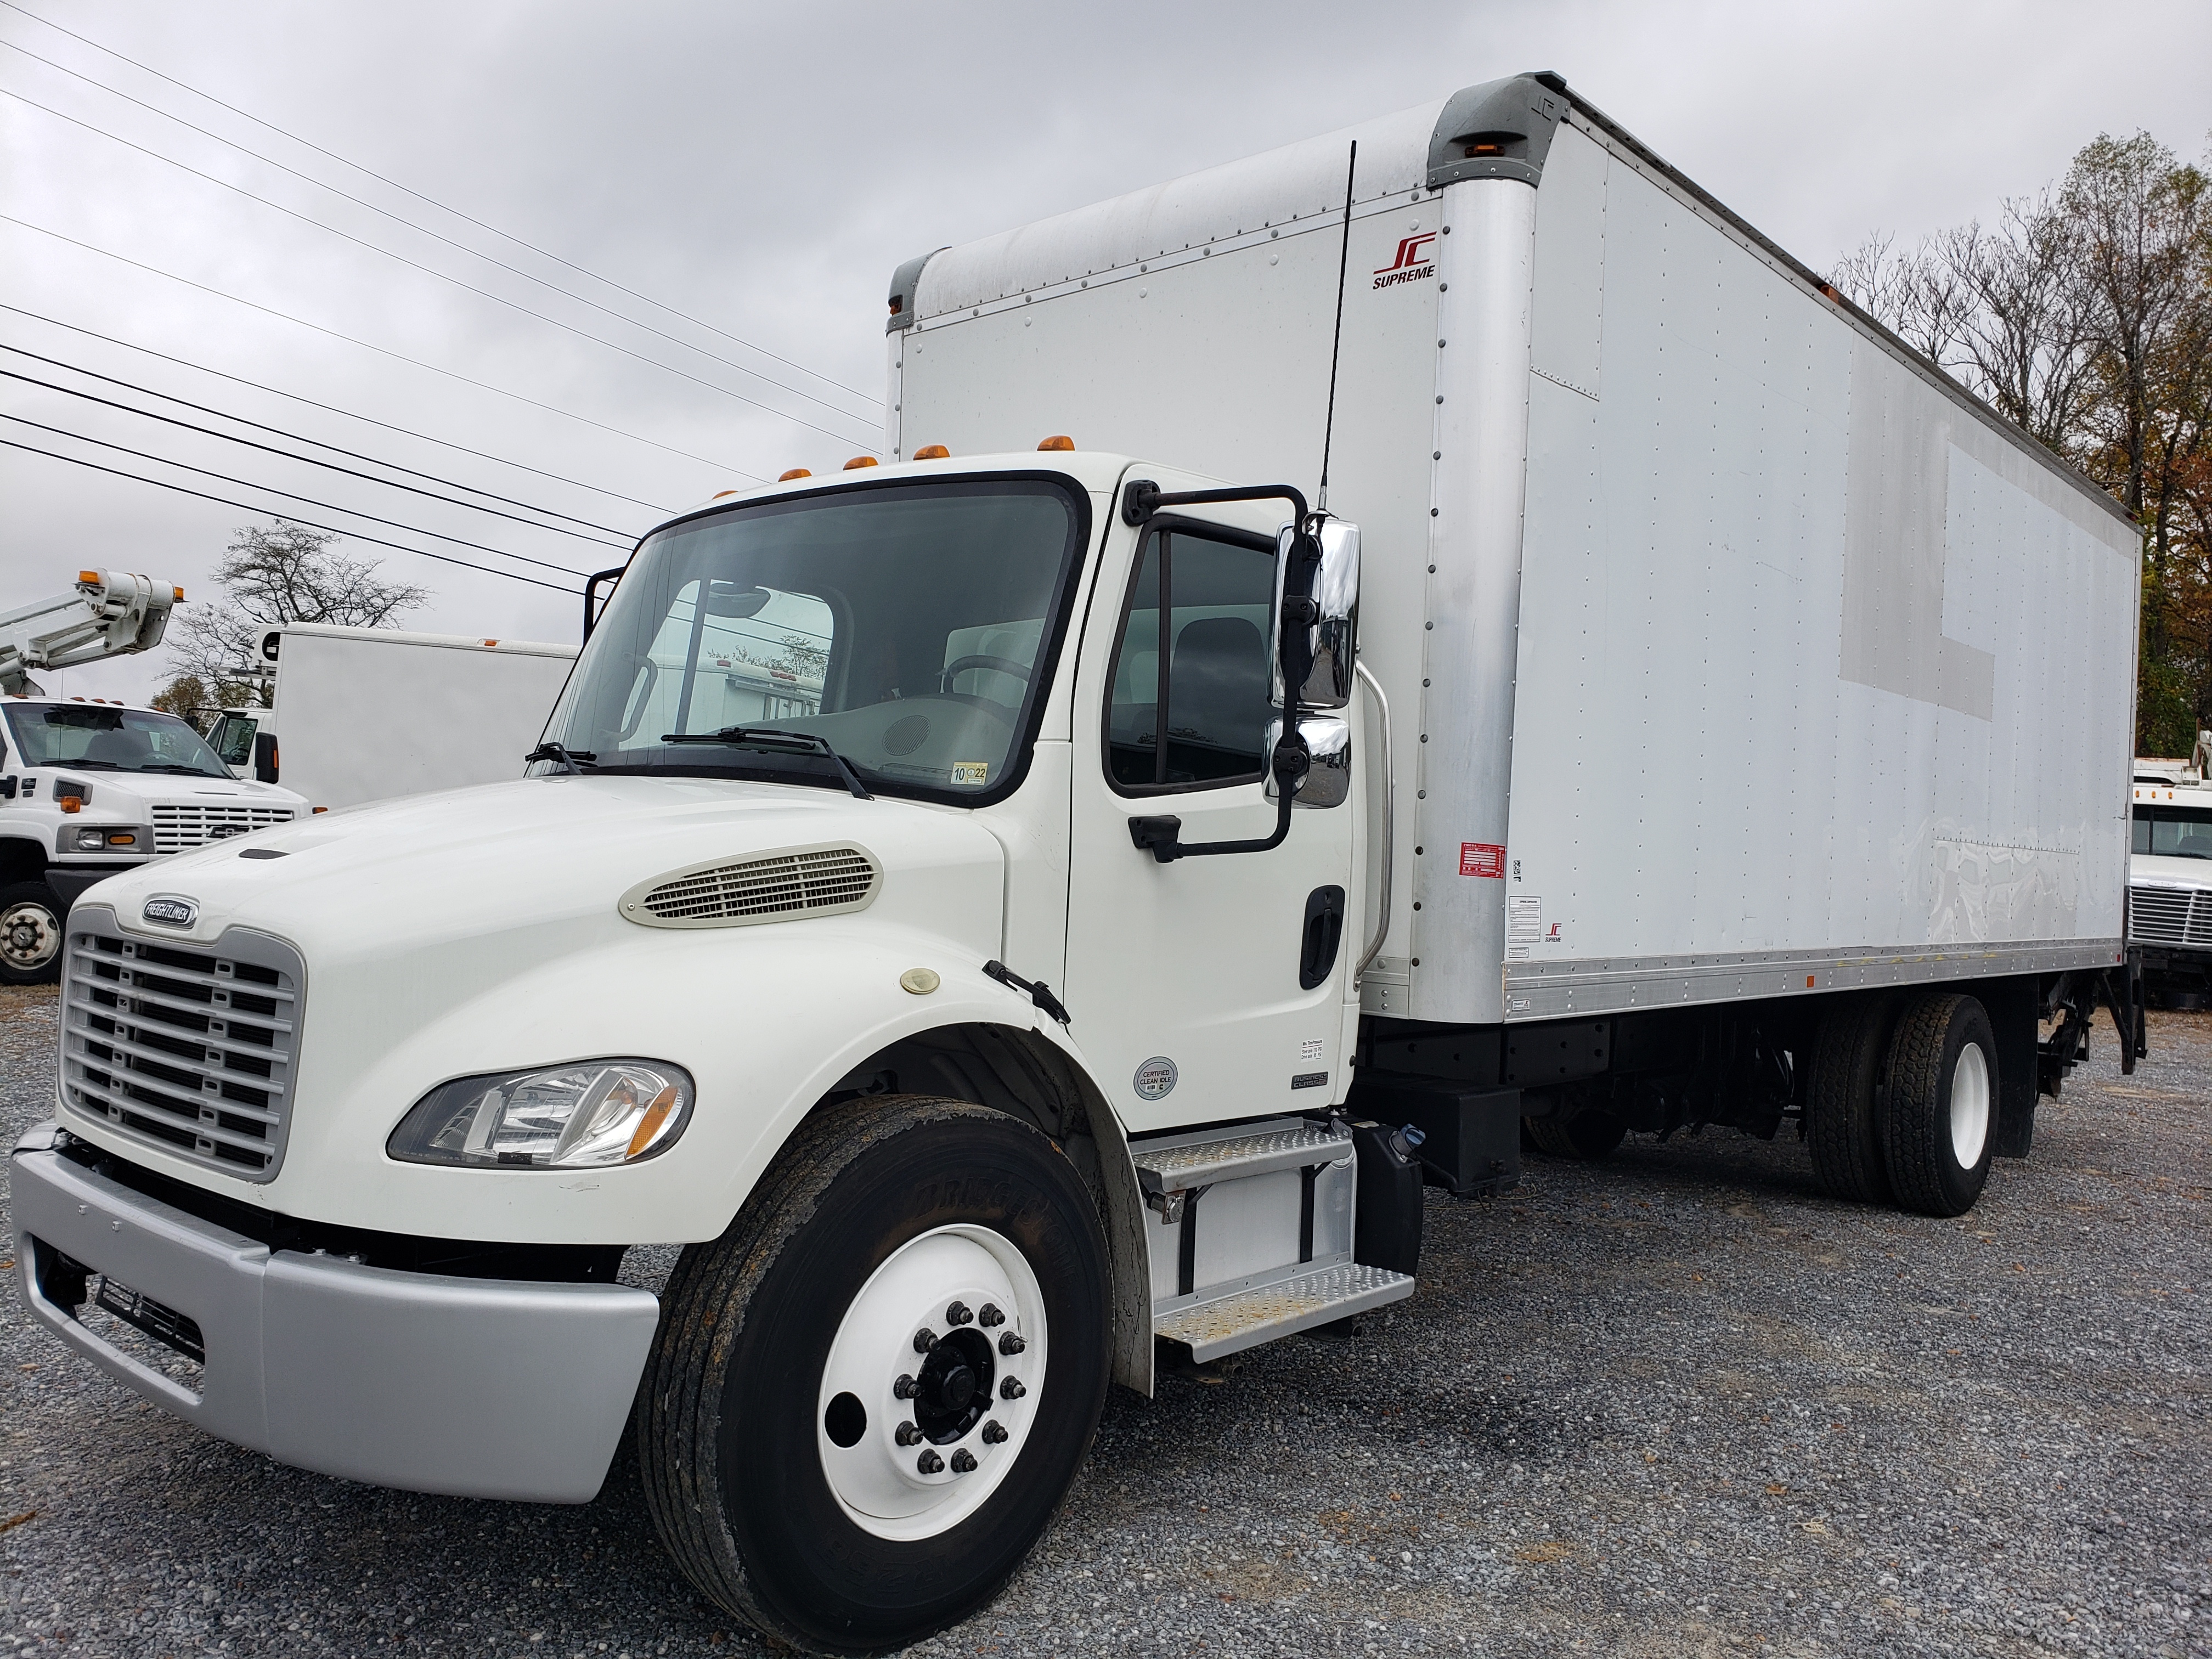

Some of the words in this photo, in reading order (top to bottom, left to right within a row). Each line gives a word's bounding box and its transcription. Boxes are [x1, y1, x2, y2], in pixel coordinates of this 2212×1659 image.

[1373, 264, 1436, 290] SUPREME
[955, 768, 965, 781] 10
[975, 768, 985, 777] 22
[145, 903, 189, 920] FREIGHTLINER
[913, 1176, 1080, 1284] BRIDGESTONE
